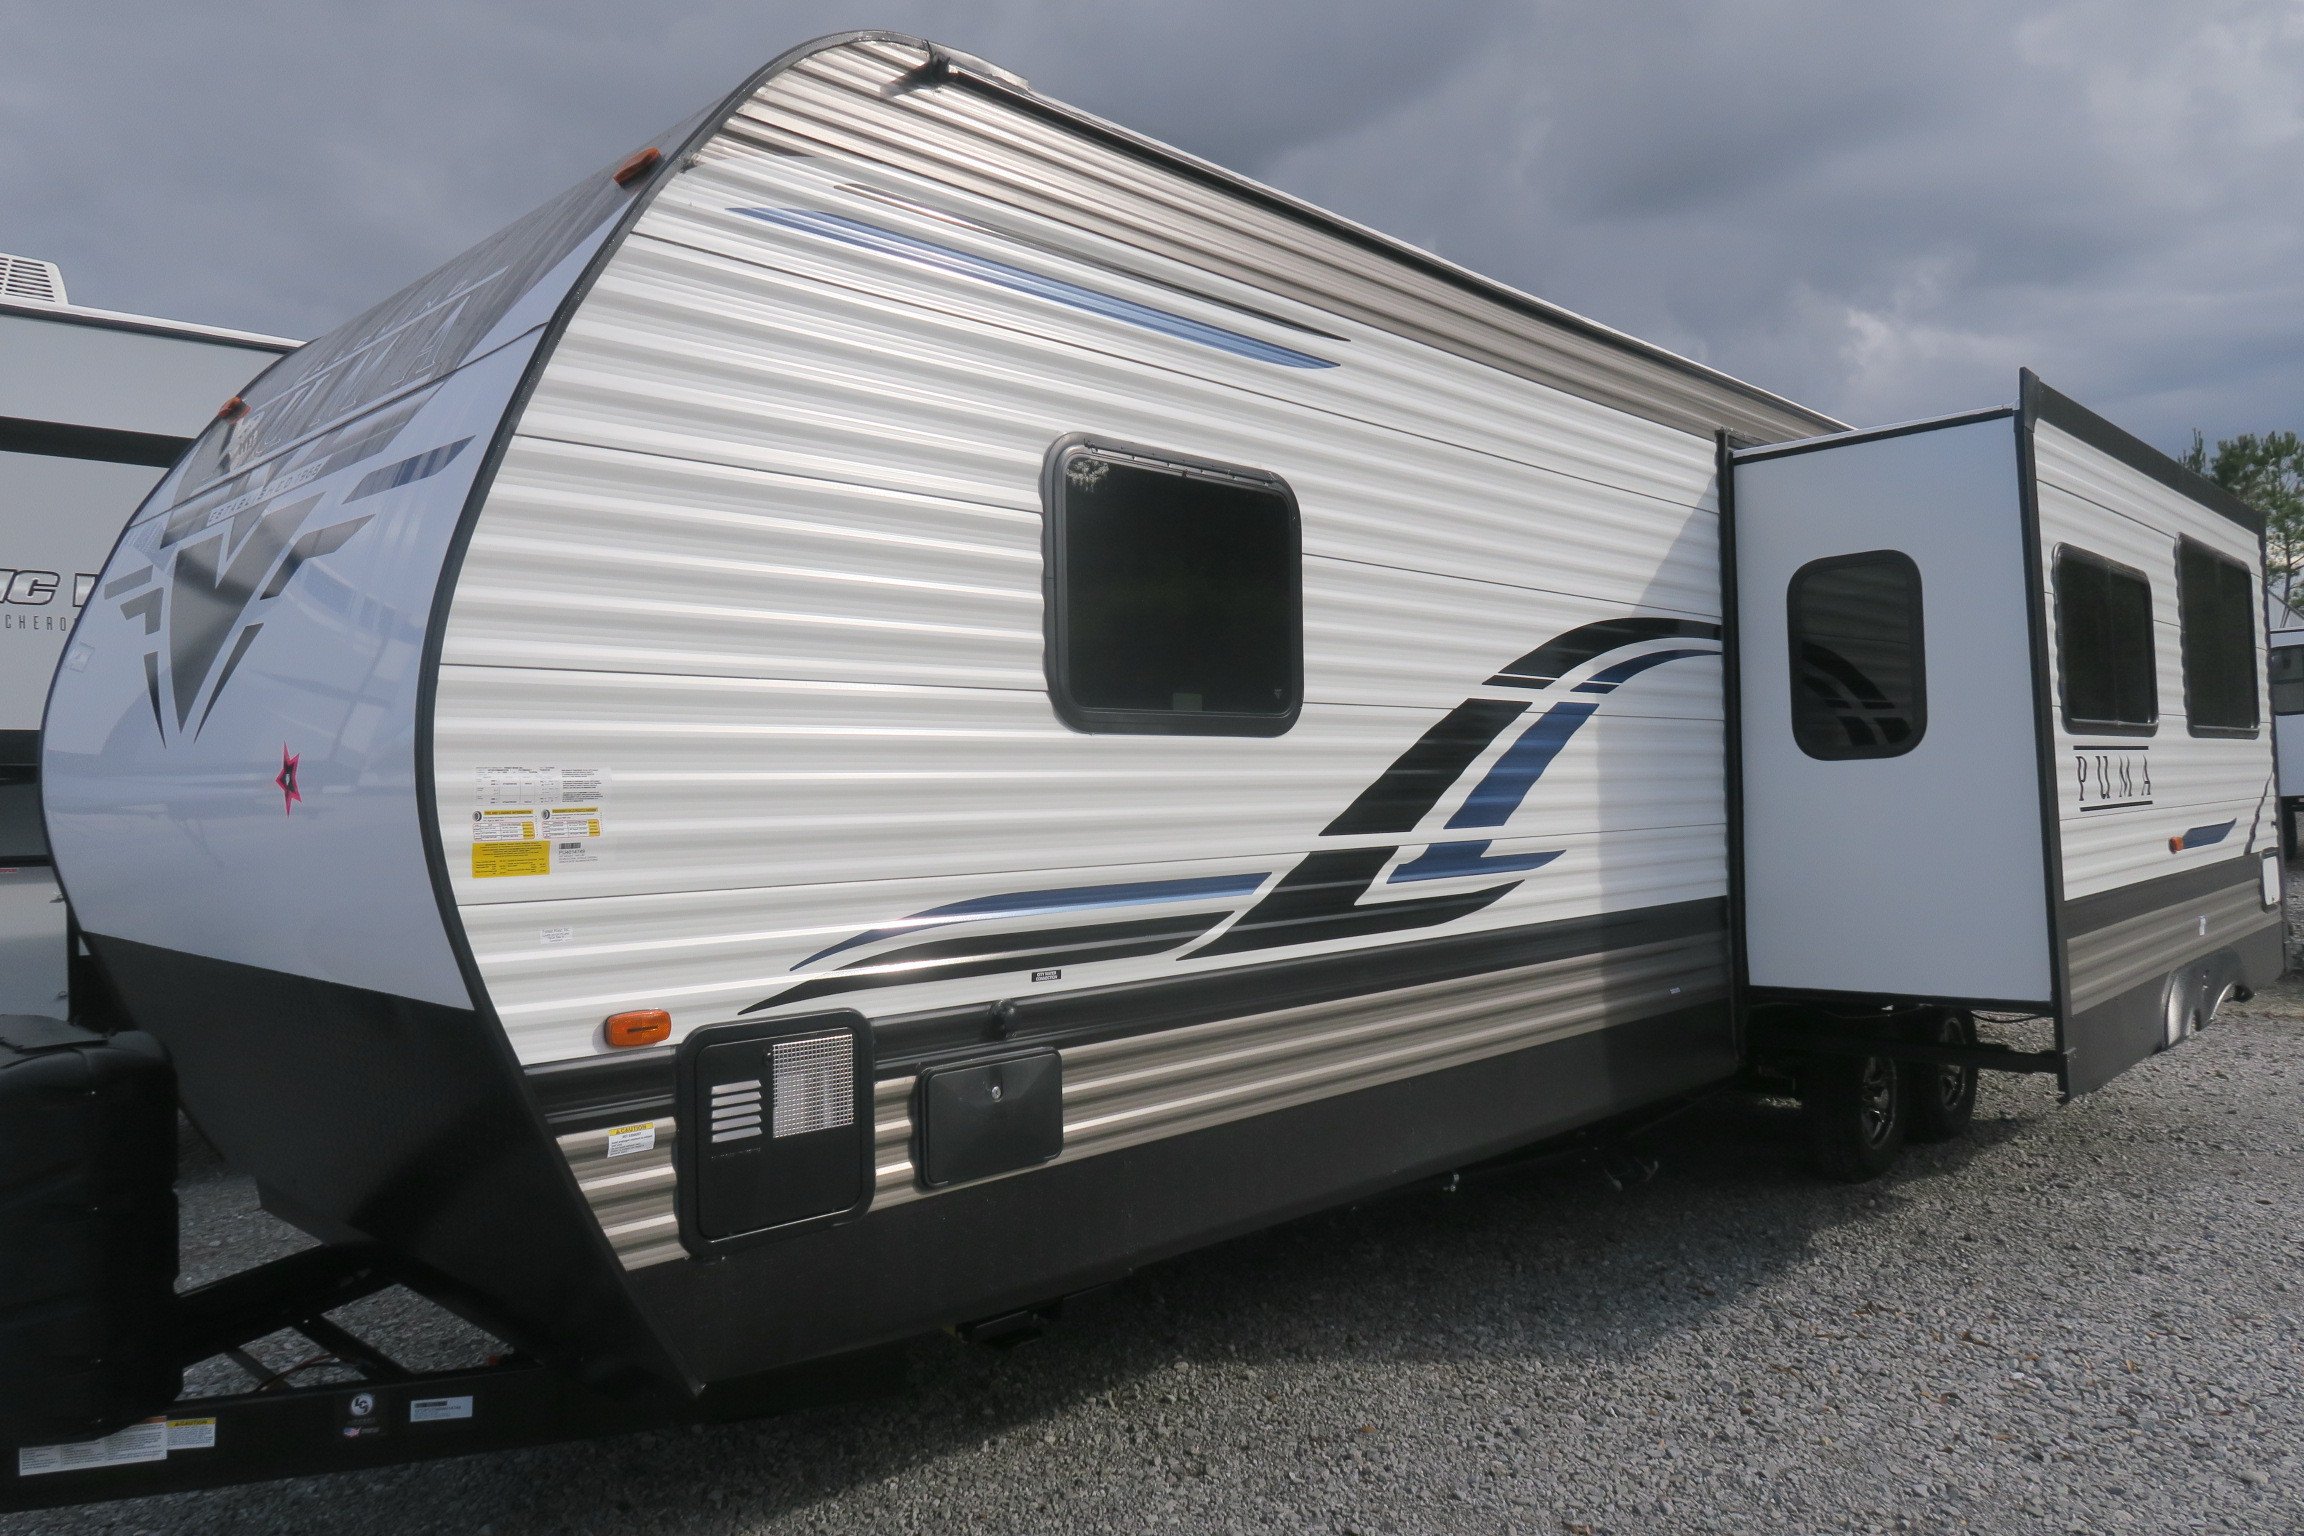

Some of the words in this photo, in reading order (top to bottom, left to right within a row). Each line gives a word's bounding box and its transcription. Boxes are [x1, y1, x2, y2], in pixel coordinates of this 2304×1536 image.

[5, 613, 78, 632] CHERO
[2075, 754, 2151, 801] PUMA
[619, 1124, 647, 1133] CAUTION
